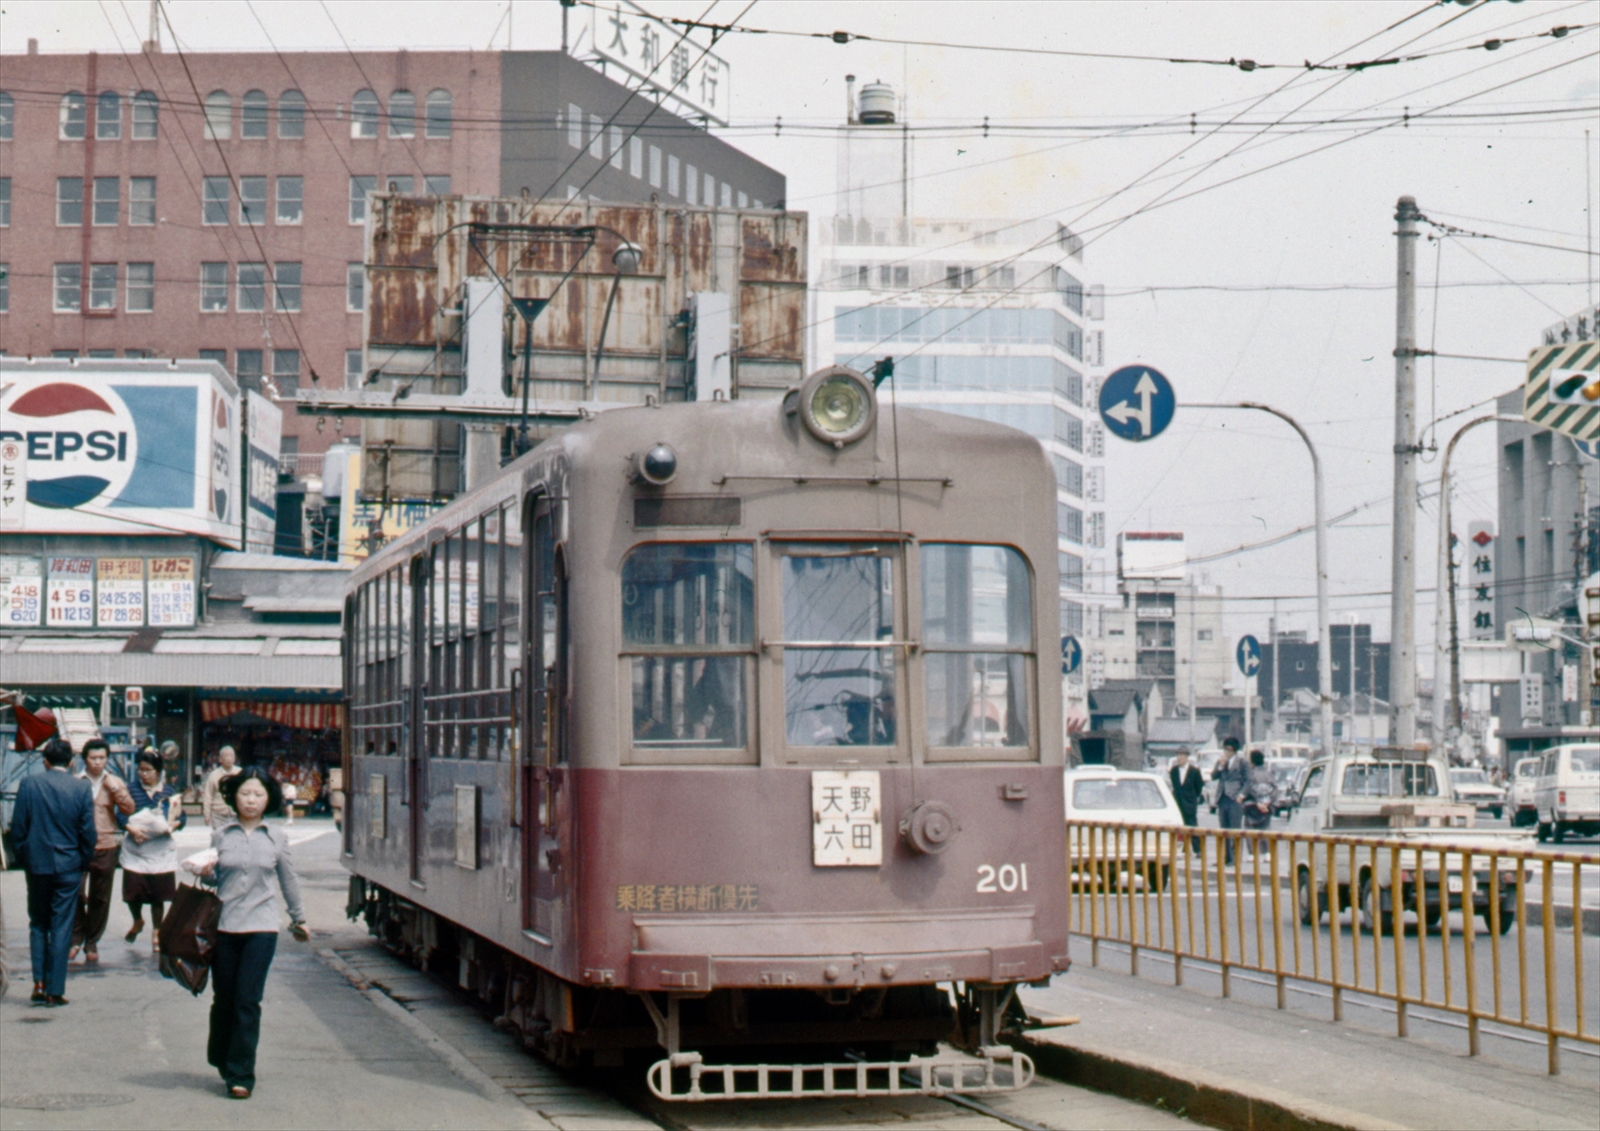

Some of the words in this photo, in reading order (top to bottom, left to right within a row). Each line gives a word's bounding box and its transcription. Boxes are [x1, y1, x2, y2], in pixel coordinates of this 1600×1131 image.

[608, 3, 718, 108] 大和銀行
[3, 465, 15, 507] ヒチヤ
[100, 561, 140, 574] 甲子園
[12, 585, 23, 596] 4
[51, 590, 61, 602] 4
[65, 589, 76, 602] 5
[79, 588, 91, 603] 6
[11, 597, 23, 609] 5
[100, 592, 113, 605] 24
[114, 592, 127, 605] 25
[128, 592, 142, 605] 26
[1474, 555, 1493, 641] 住友銀
[11, 609, 22, 621] 6
[50, 607, 62, 620] 11
[64, 607, 76, 620] 12
[79, 607, 91, 620] 13
[100, 608, 113, 621] 27
[128, 608, 142, 621] 29
[976, 863, 1028, 893] 201
